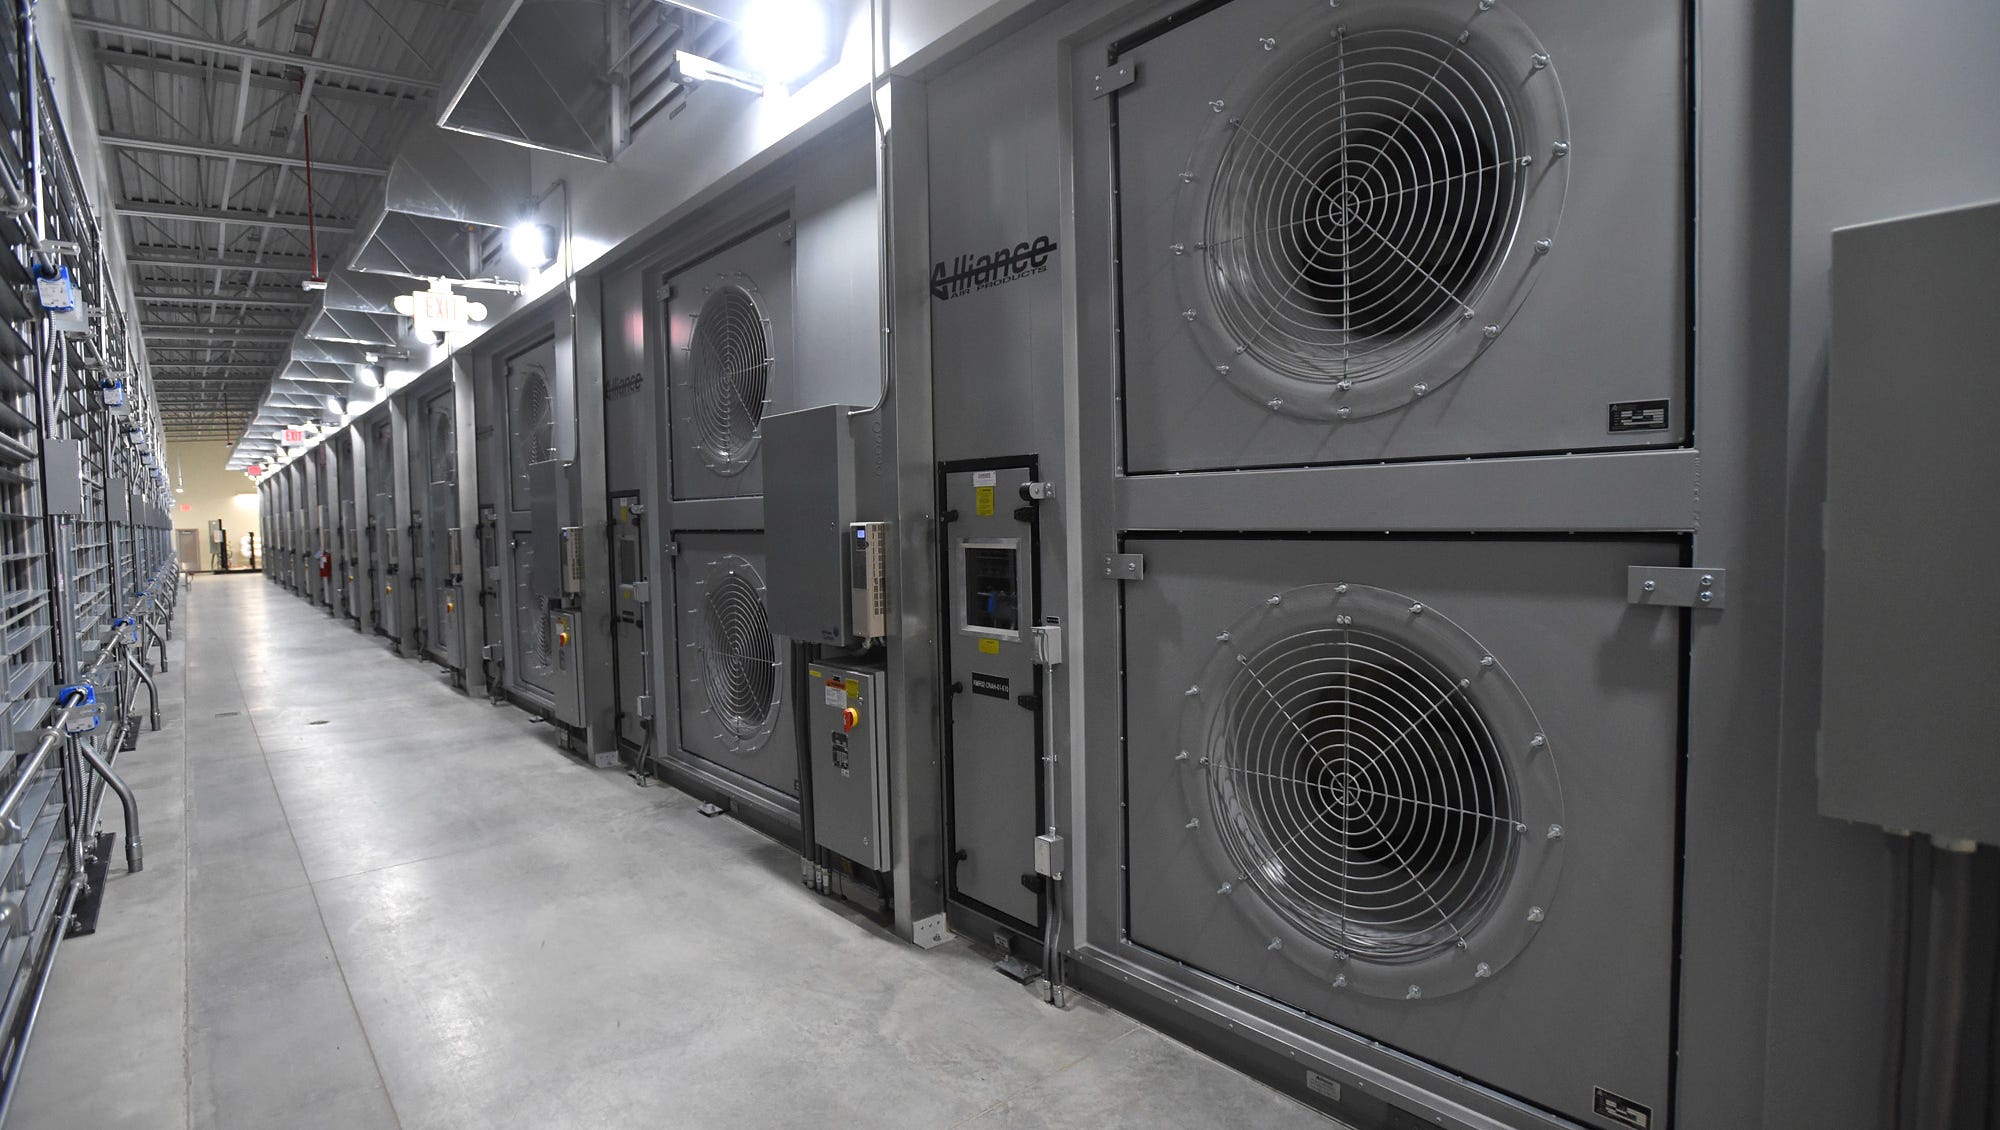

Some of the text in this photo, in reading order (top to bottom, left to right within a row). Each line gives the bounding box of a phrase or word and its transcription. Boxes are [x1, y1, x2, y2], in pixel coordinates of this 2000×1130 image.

[930, 235, 1058, 301] Alliance
[950, 265, 1048, 299] AIR PRODUCTS
[425, 296, 458, 321] EXIT
[285, 429, 303, 442] EXIT
